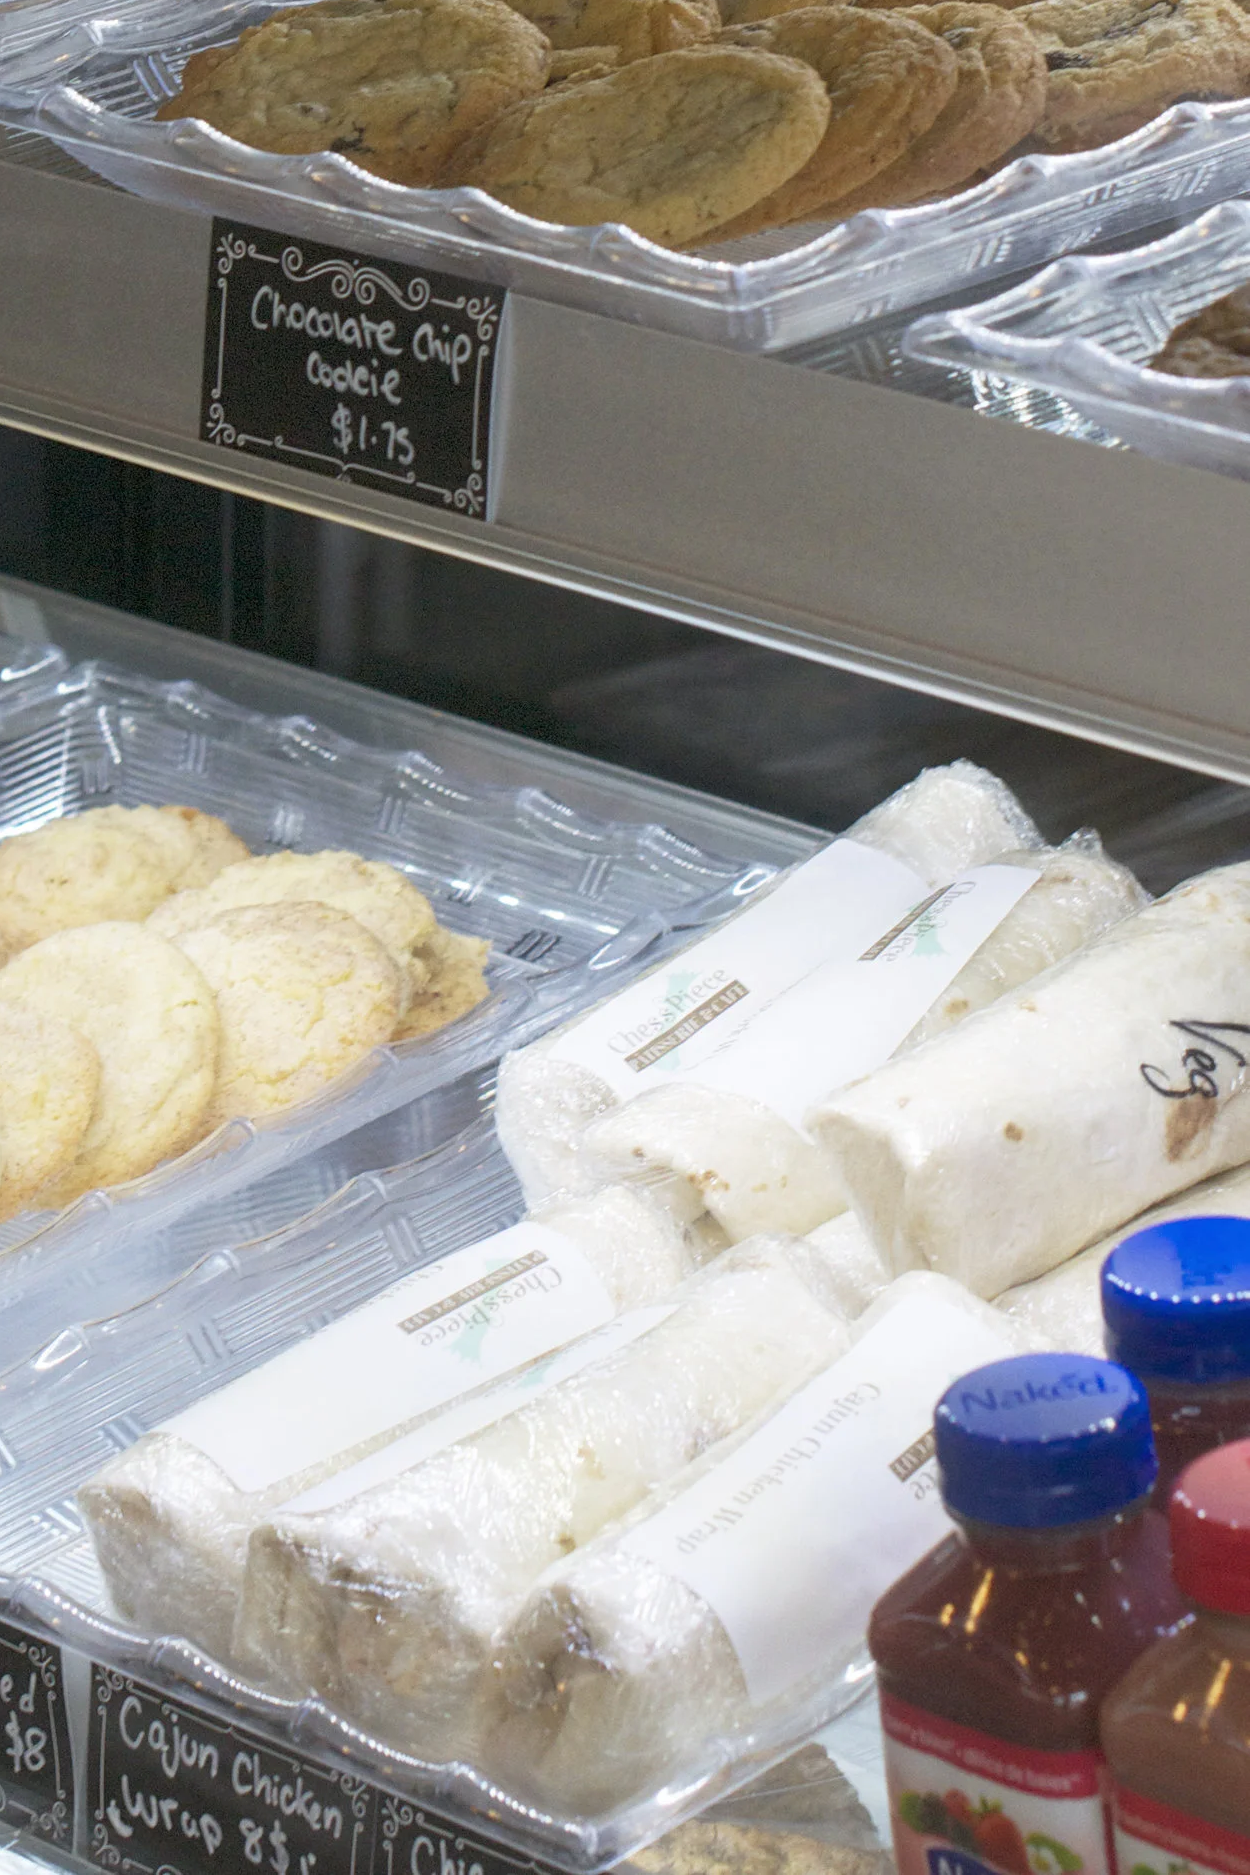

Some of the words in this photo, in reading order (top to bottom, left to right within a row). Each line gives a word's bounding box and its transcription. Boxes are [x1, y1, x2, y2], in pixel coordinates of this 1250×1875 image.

[251, 285, 403, 356] Chocolate
[412, 322, 472, 385] Chip
[307, 350, 402, 406] Cookie
[331, 402, 415, 465] $1.75
[604, 967, 729, 1053] ChessPiece
[4, 1709, 49, 1773] $8
[119, 1695, 219, 1778] Cajun
[231, 1751, 343, 1840] Chicken
